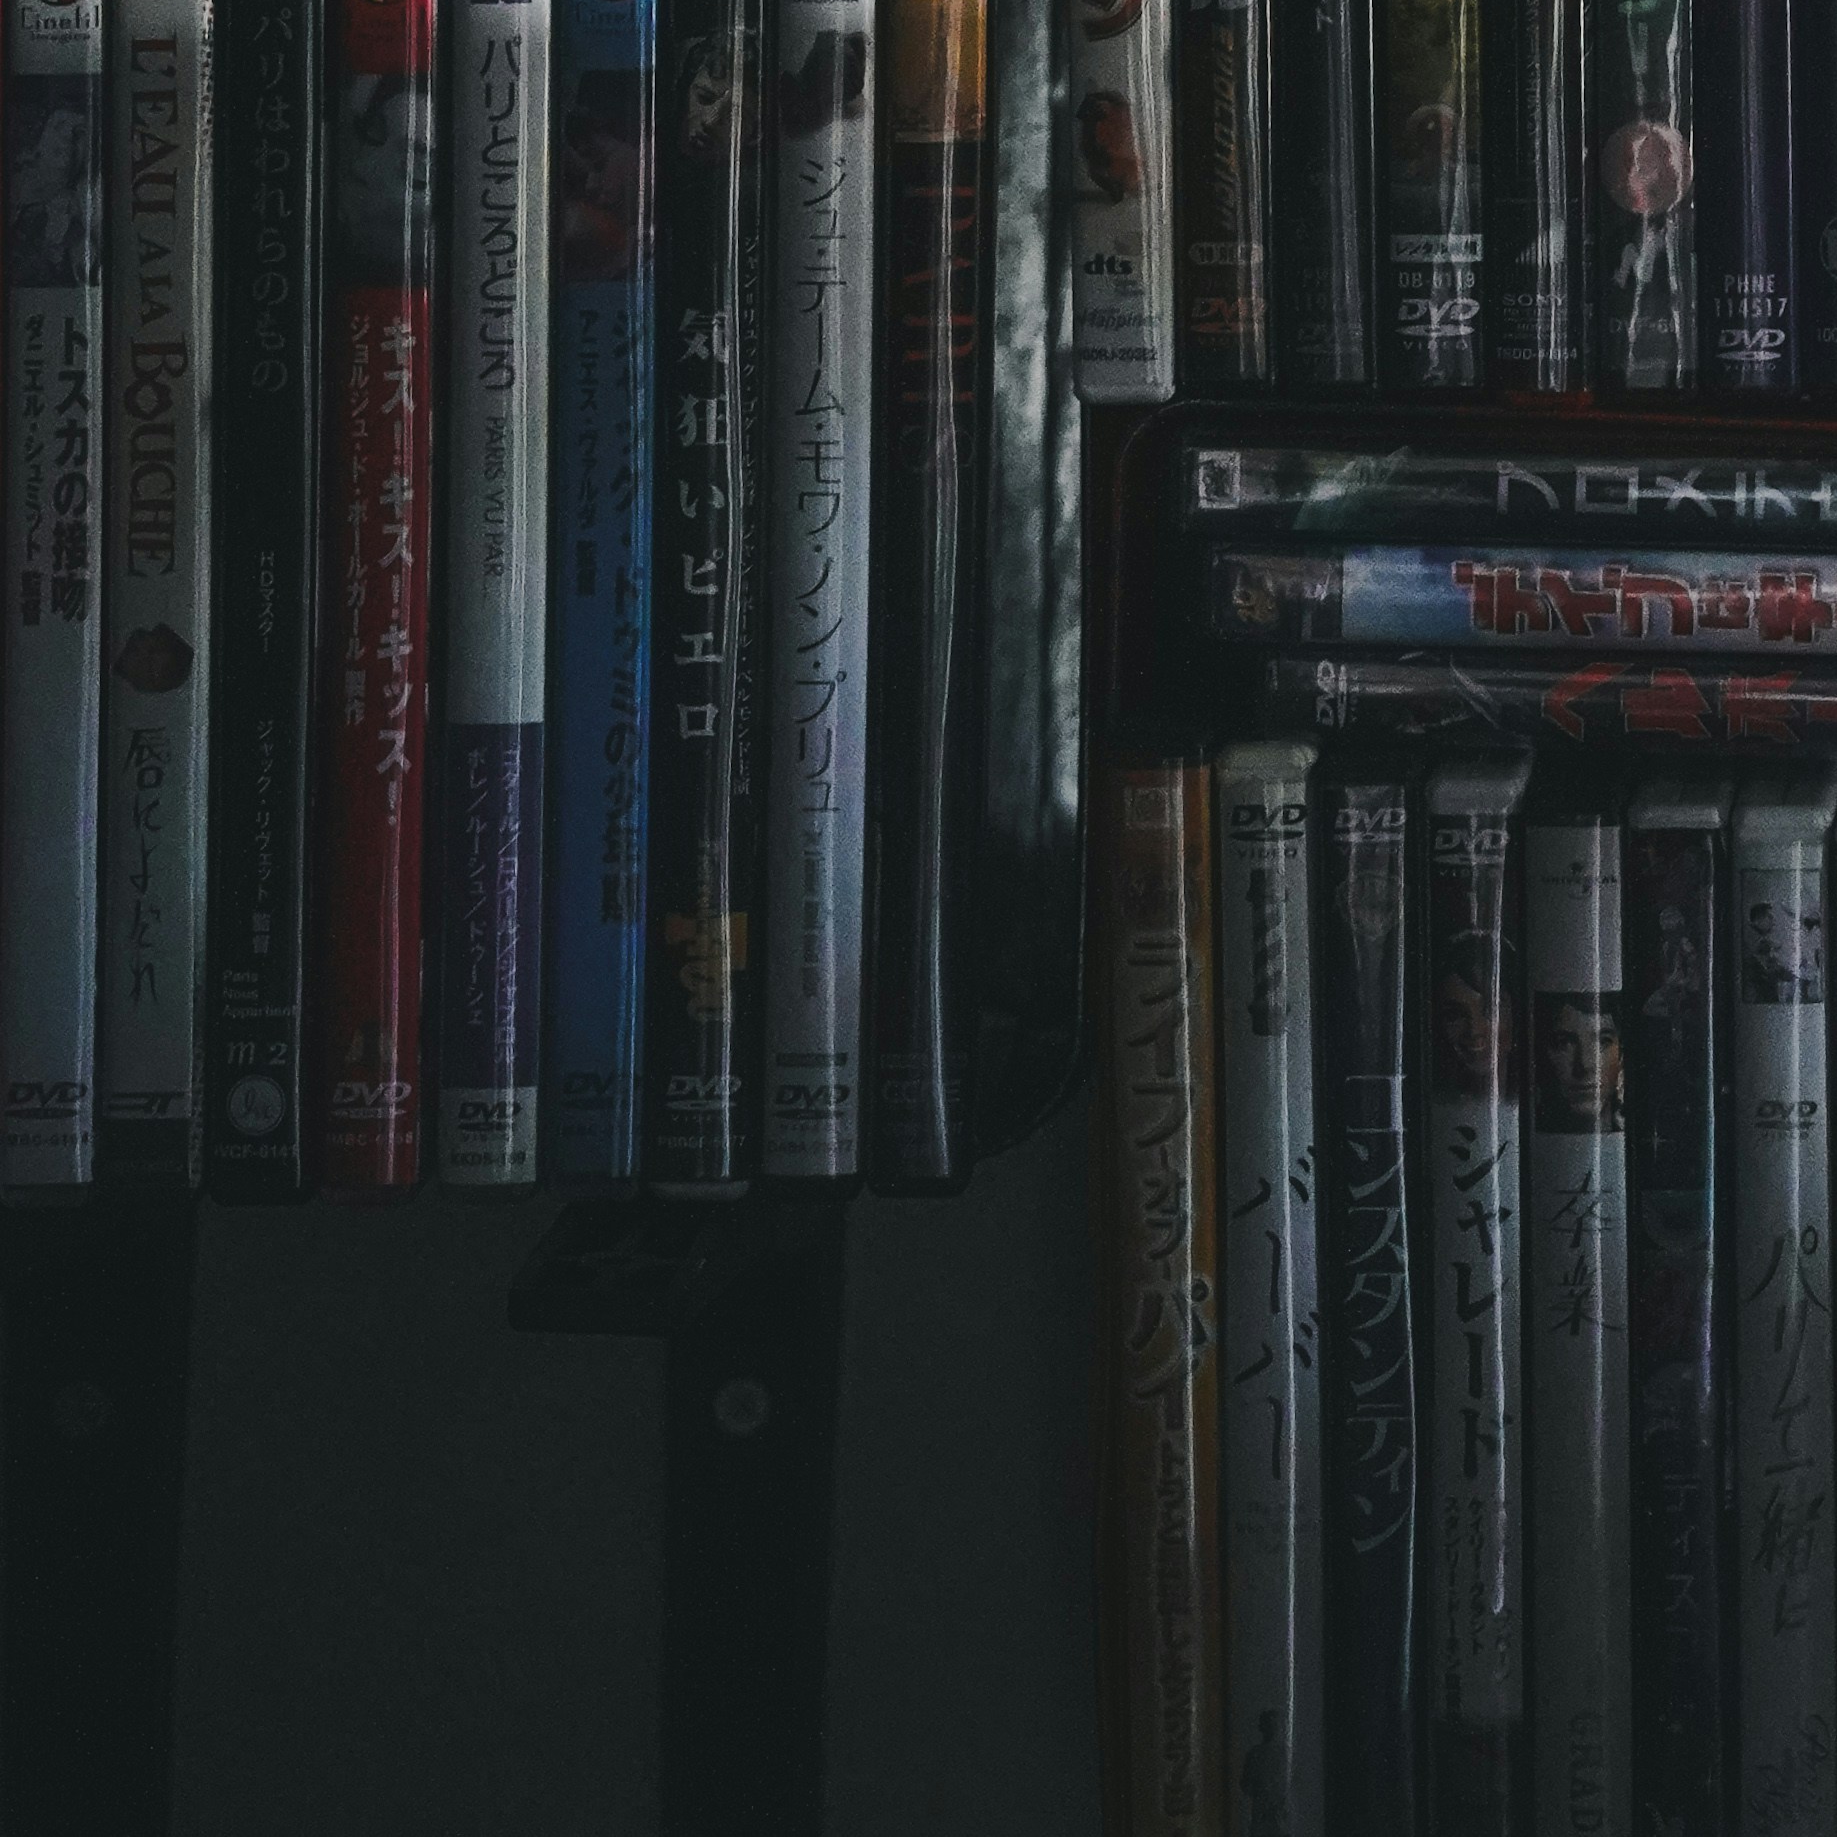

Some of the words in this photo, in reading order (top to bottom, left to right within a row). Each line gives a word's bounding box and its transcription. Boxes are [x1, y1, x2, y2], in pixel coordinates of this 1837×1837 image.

[130, 35, 180, 223] L'EAU
[250, 5, 294, 394] パリはわれらのもの
[478, 35, 523, 395] パリところどころ
[1084, 252, 1133, 277] dts
[51, 316, 90, 624] トスカの接吻
[123, 331, 189, 580] BOUCHE
[257, 550, 276, 654] HDマスター
[673, 306, 733, 741] 気狂いピエロ
[124, 727, 172, 1009] 唇によだれ
[1231, 1141, 1318, 1480] バーバー
[1344, 1074, 1415, 1555] コンスタンティン
[1444, 1126, 1512, 1480] シャレード
[1550, 1172, 1616, 1335] 卒業
